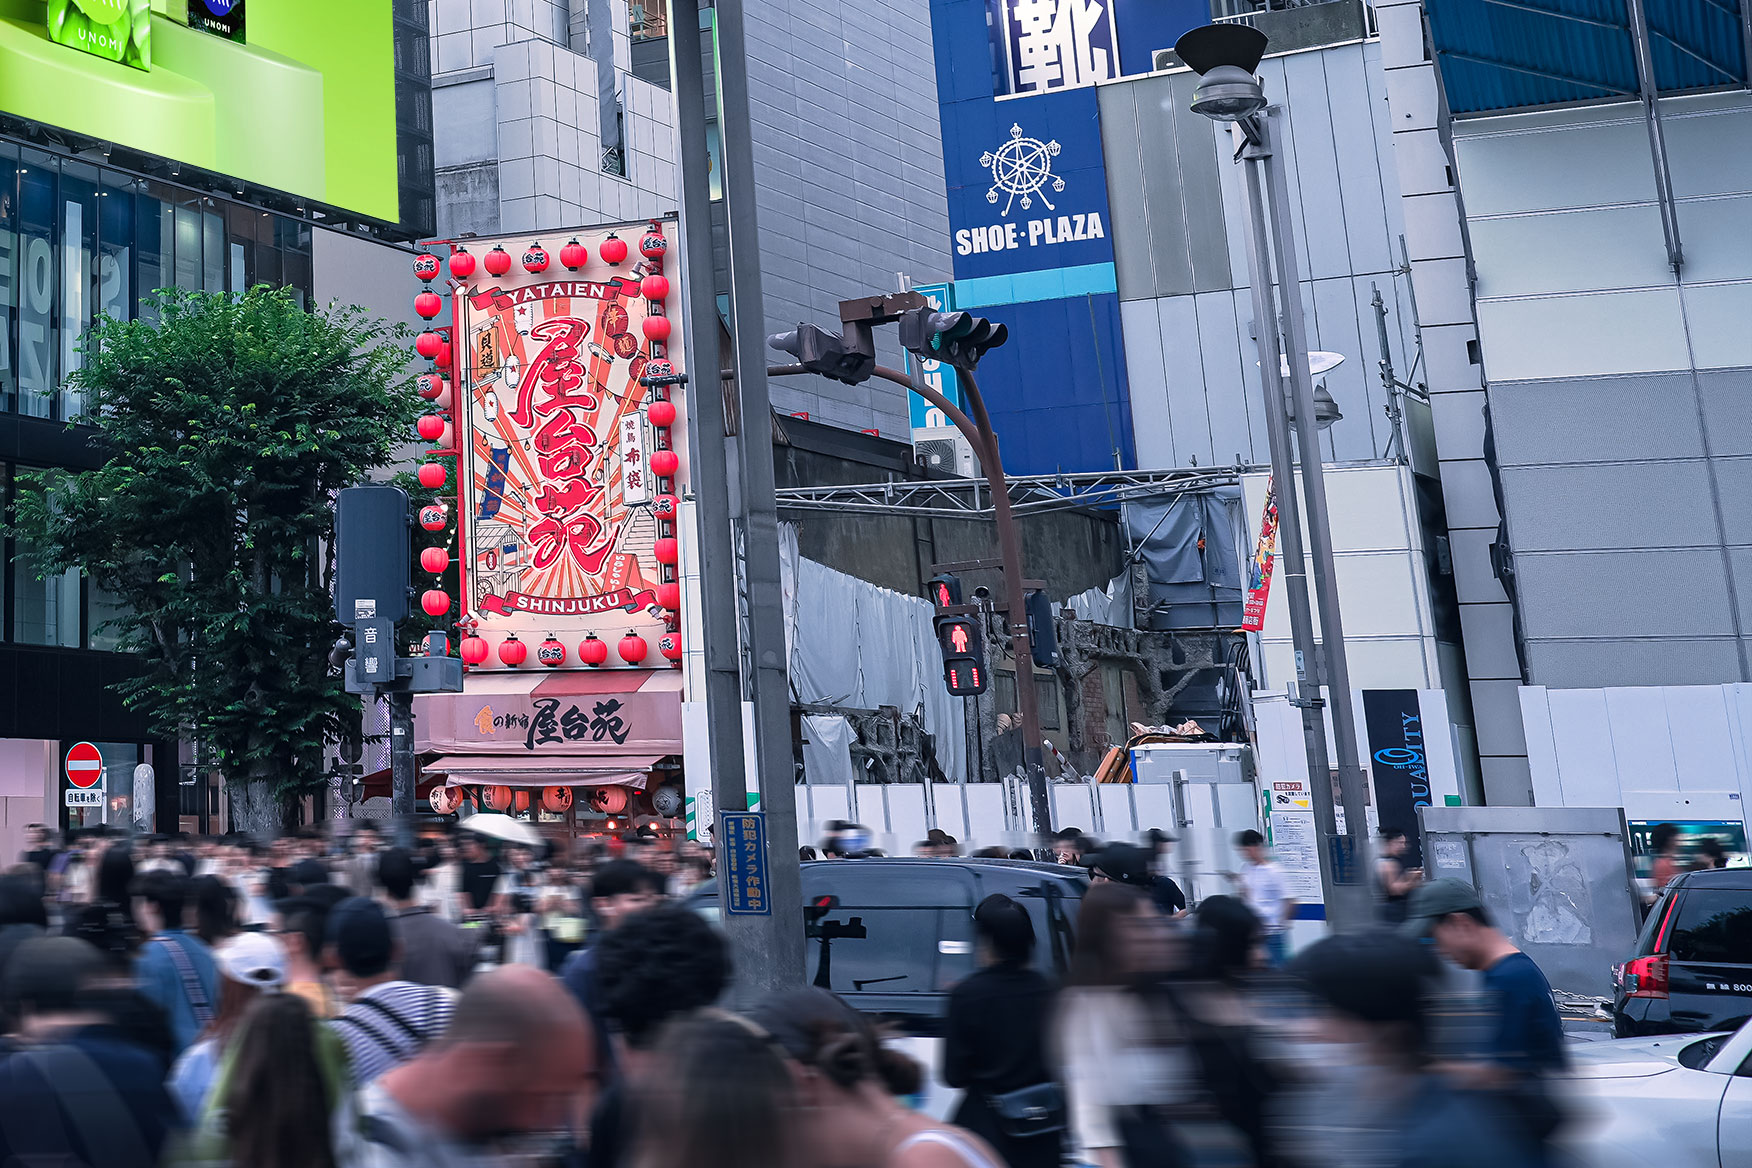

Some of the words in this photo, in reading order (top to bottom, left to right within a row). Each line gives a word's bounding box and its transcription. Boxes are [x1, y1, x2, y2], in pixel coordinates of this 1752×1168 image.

[204, 17, 230, 33] UNOMI
[78, 27, 122, 52] UNOMI
[506, 284, 606, 306] YATAIEN
[508, 316, 620, 576] 屋台苑
[624, 447, 643, 489] 布袋
[517, 594, 620, 613] SHINJUKU
[364, 627, 378, 674] 音響
[523, 697, 632, 750] 屋台苑
[68, 792, 100, 803] 自転車を除く
